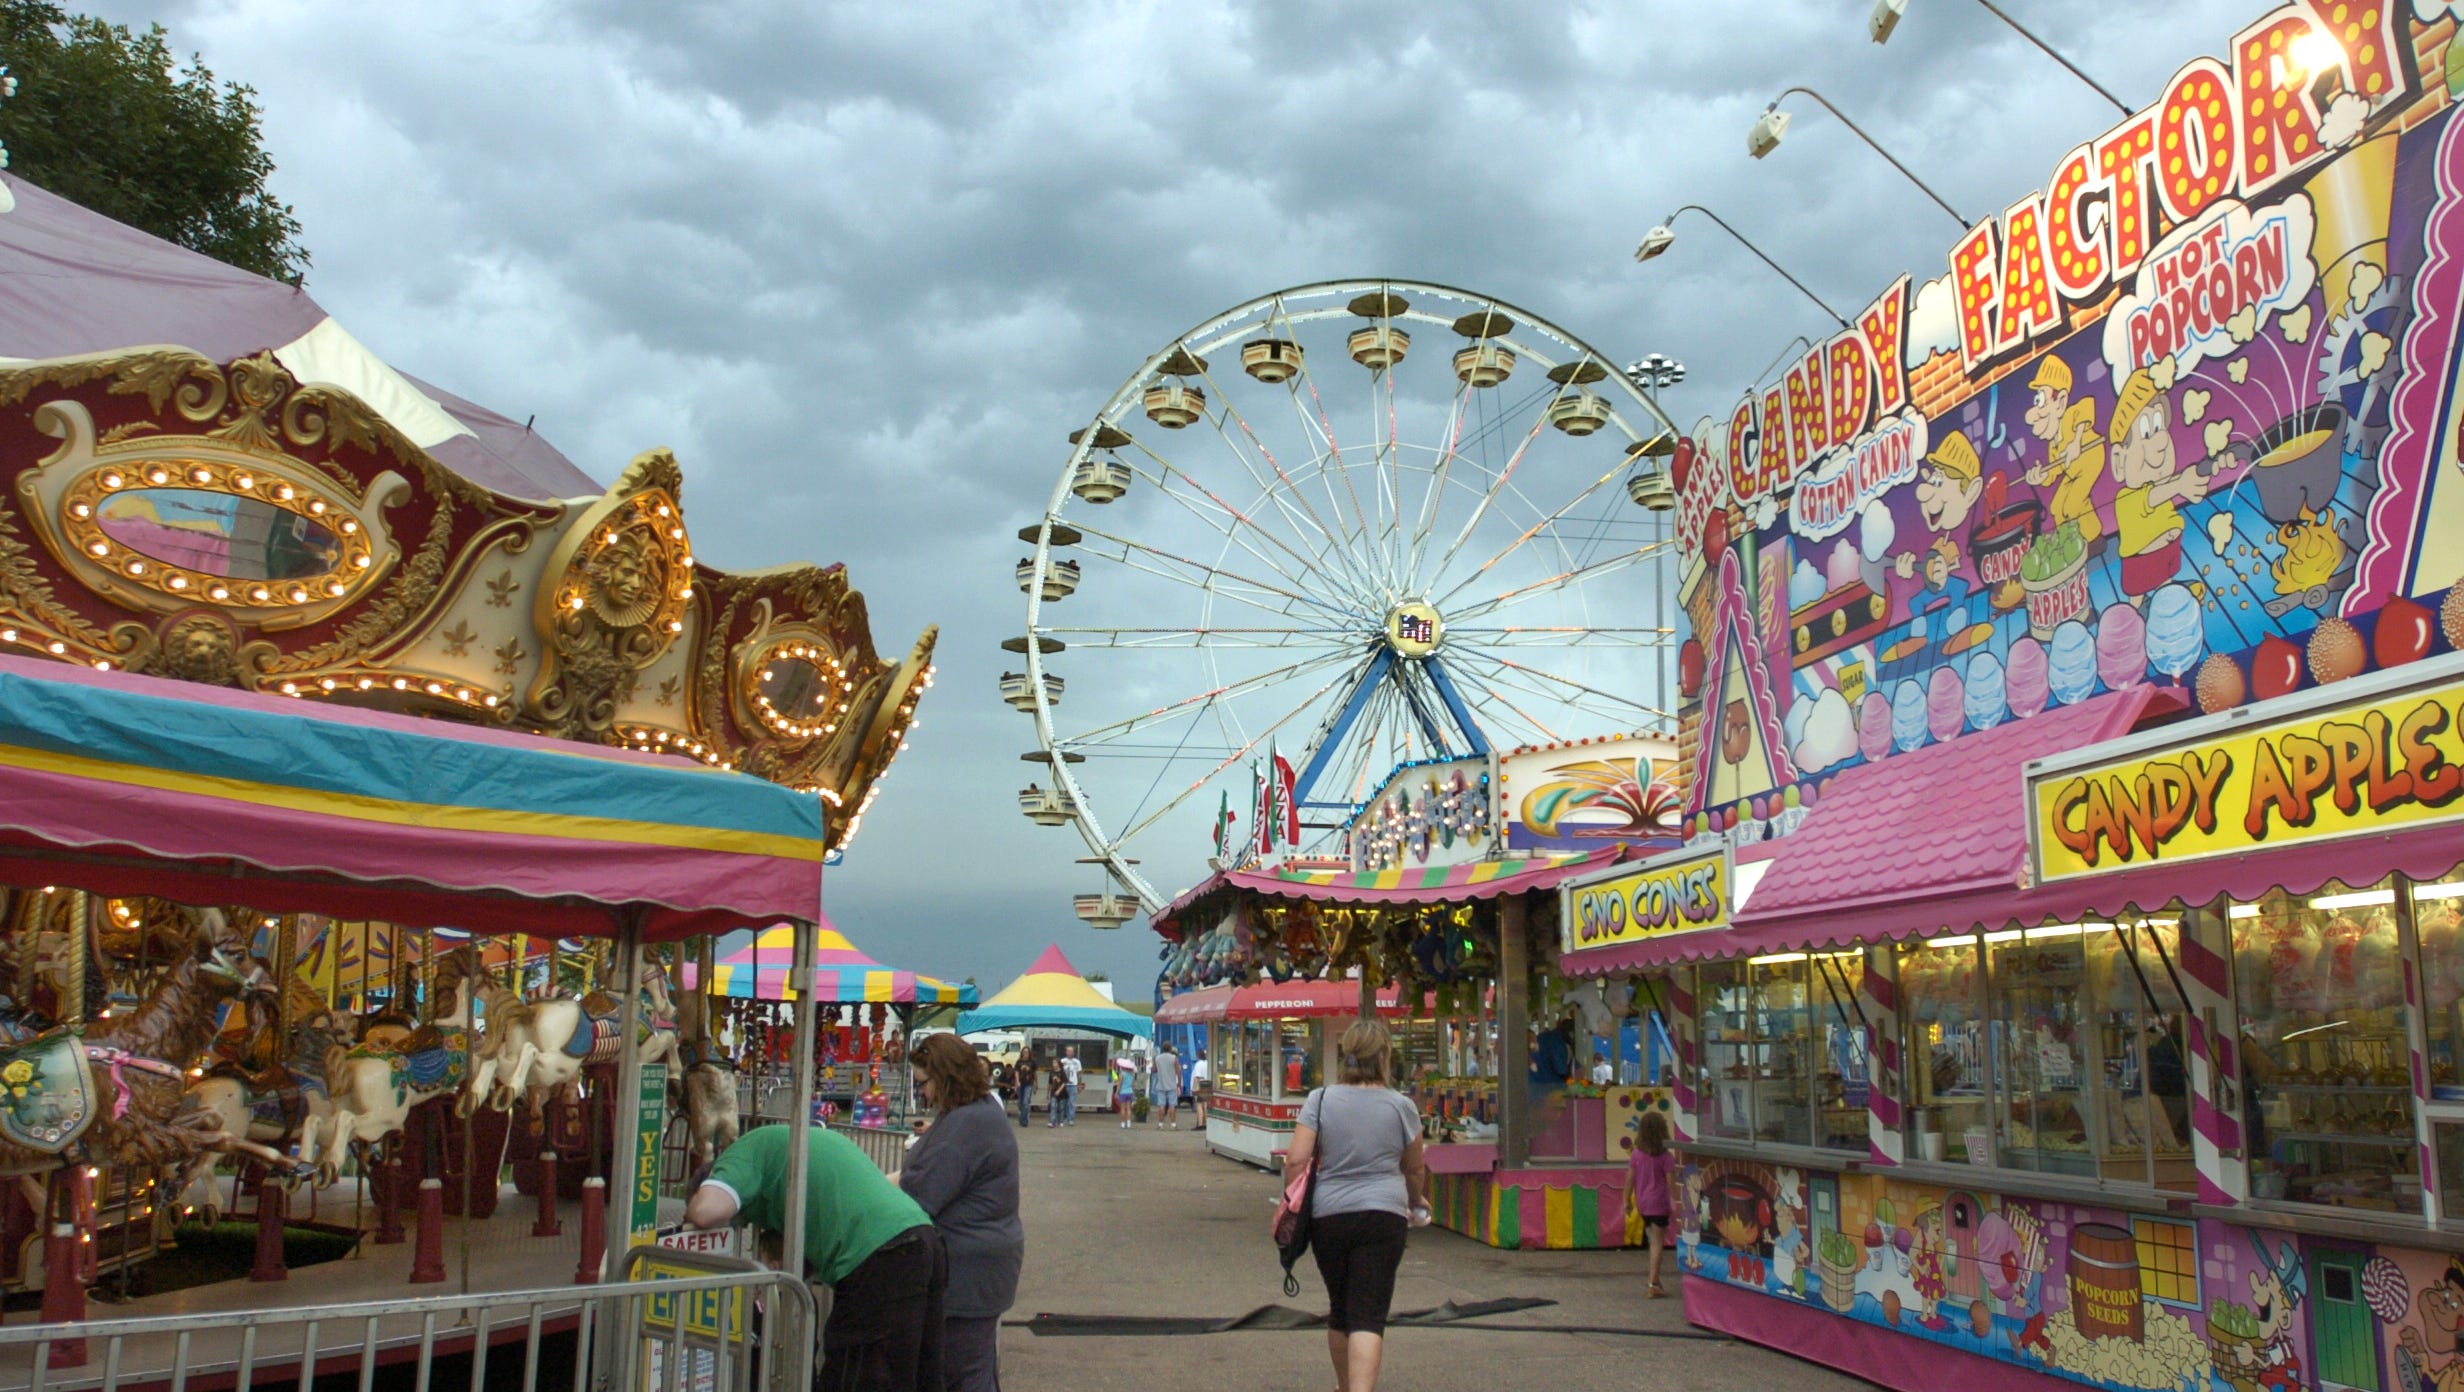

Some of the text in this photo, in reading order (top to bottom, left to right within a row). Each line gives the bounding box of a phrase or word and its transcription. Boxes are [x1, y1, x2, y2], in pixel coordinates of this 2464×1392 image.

[1728, 0, 2402, 503] CANDY FACTORY
[2156, 223, 2223, 297] HOT
[2130, 226, 2284, 369] POPCORN
[1677, 437, 1711, 537] CANDY
[1684, 456, 1725, 561] APPLES
[1799, 423, 1914, 524] COTTON CANDY
[1982, 534, 2032, 583] CANDY
[2032, 572, 2087, 628] APPLES
[1253, 775, 1266, 857] PIZZA
[1275, 769, 1287, 840] IZZA
[2053, 700, 2464, 867] CANDY APPLE
[1579, 863, 1719, 942] SNO CONES
[1255, 1000, 1314, 1009] PEPPERONI
[637, 1131, 659, 1203] YES
[663, 1231, 729, 1251] SAFETY
[653, 1271, 734, 1331] ETE
[2075, 1277, 2139, 1306] POPCORN
[2087, 1302, 2129, 1325] SEEDS
